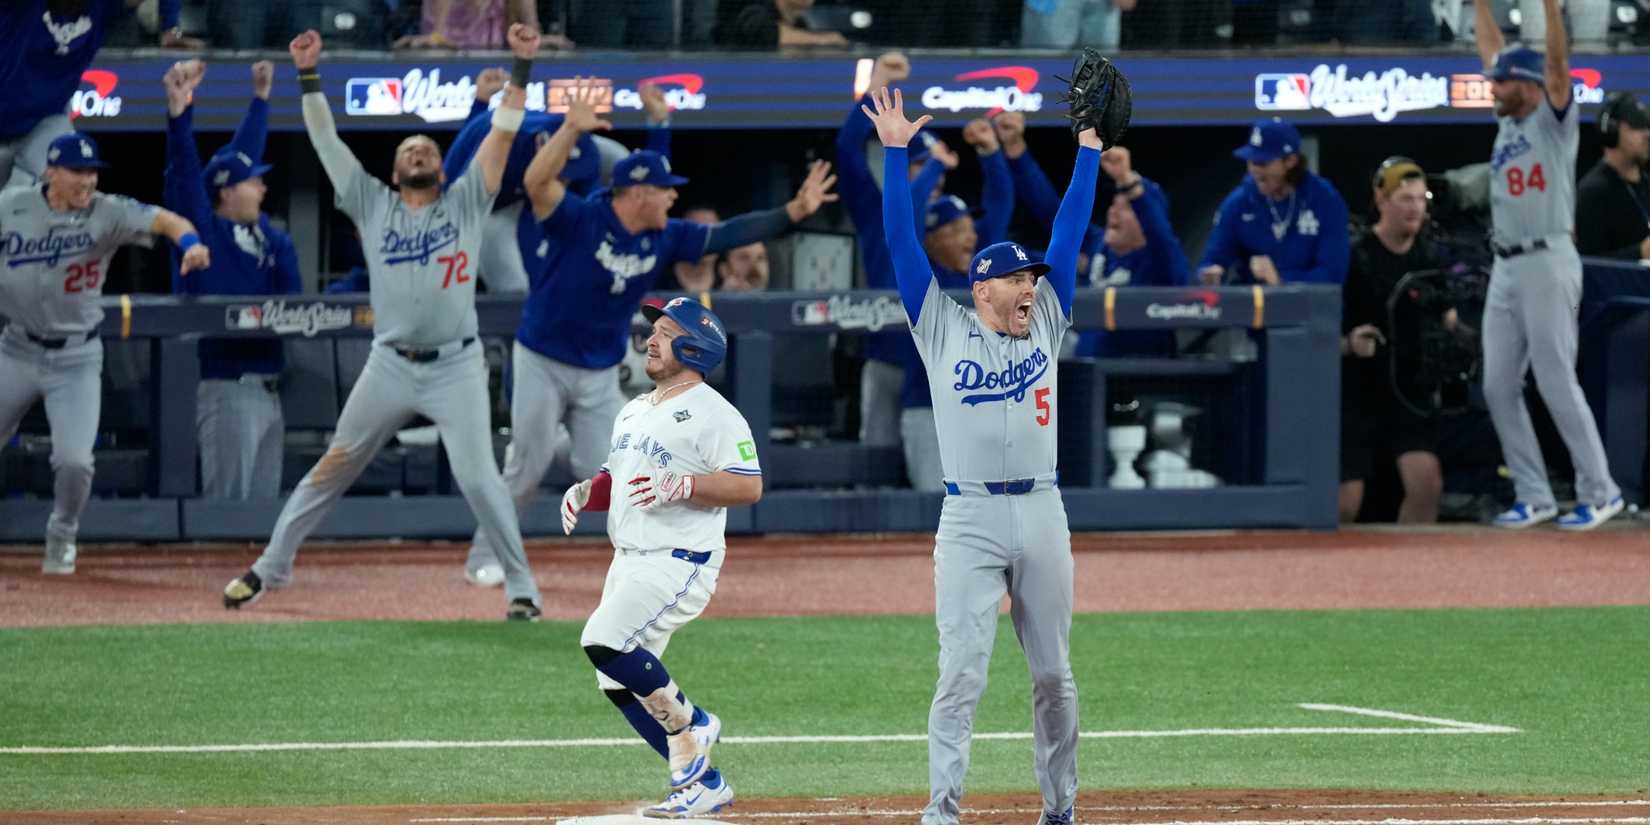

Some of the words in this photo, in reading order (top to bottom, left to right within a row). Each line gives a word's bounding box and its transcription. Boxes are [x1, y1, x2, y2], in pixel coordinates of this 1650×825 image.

[1309, 64, 1385, 118] World
[1374, 67, 1449, 122] Series
[1505, 162, 1546, 197] 84
[0, 231, 93, 268] Dodgers
[380, 221, 459, 266] Dodgers
[1011, 245, 1028, 261] LA
[64, 257, 100, 293] 25
[436, 249, 471, 289] 72
[262, 299, 306, 334] World
[954, 347, 1048, 406] Dodgers
[1034, 387, 1051, 426] 5
[632, 432, 673, 469] JAYS
